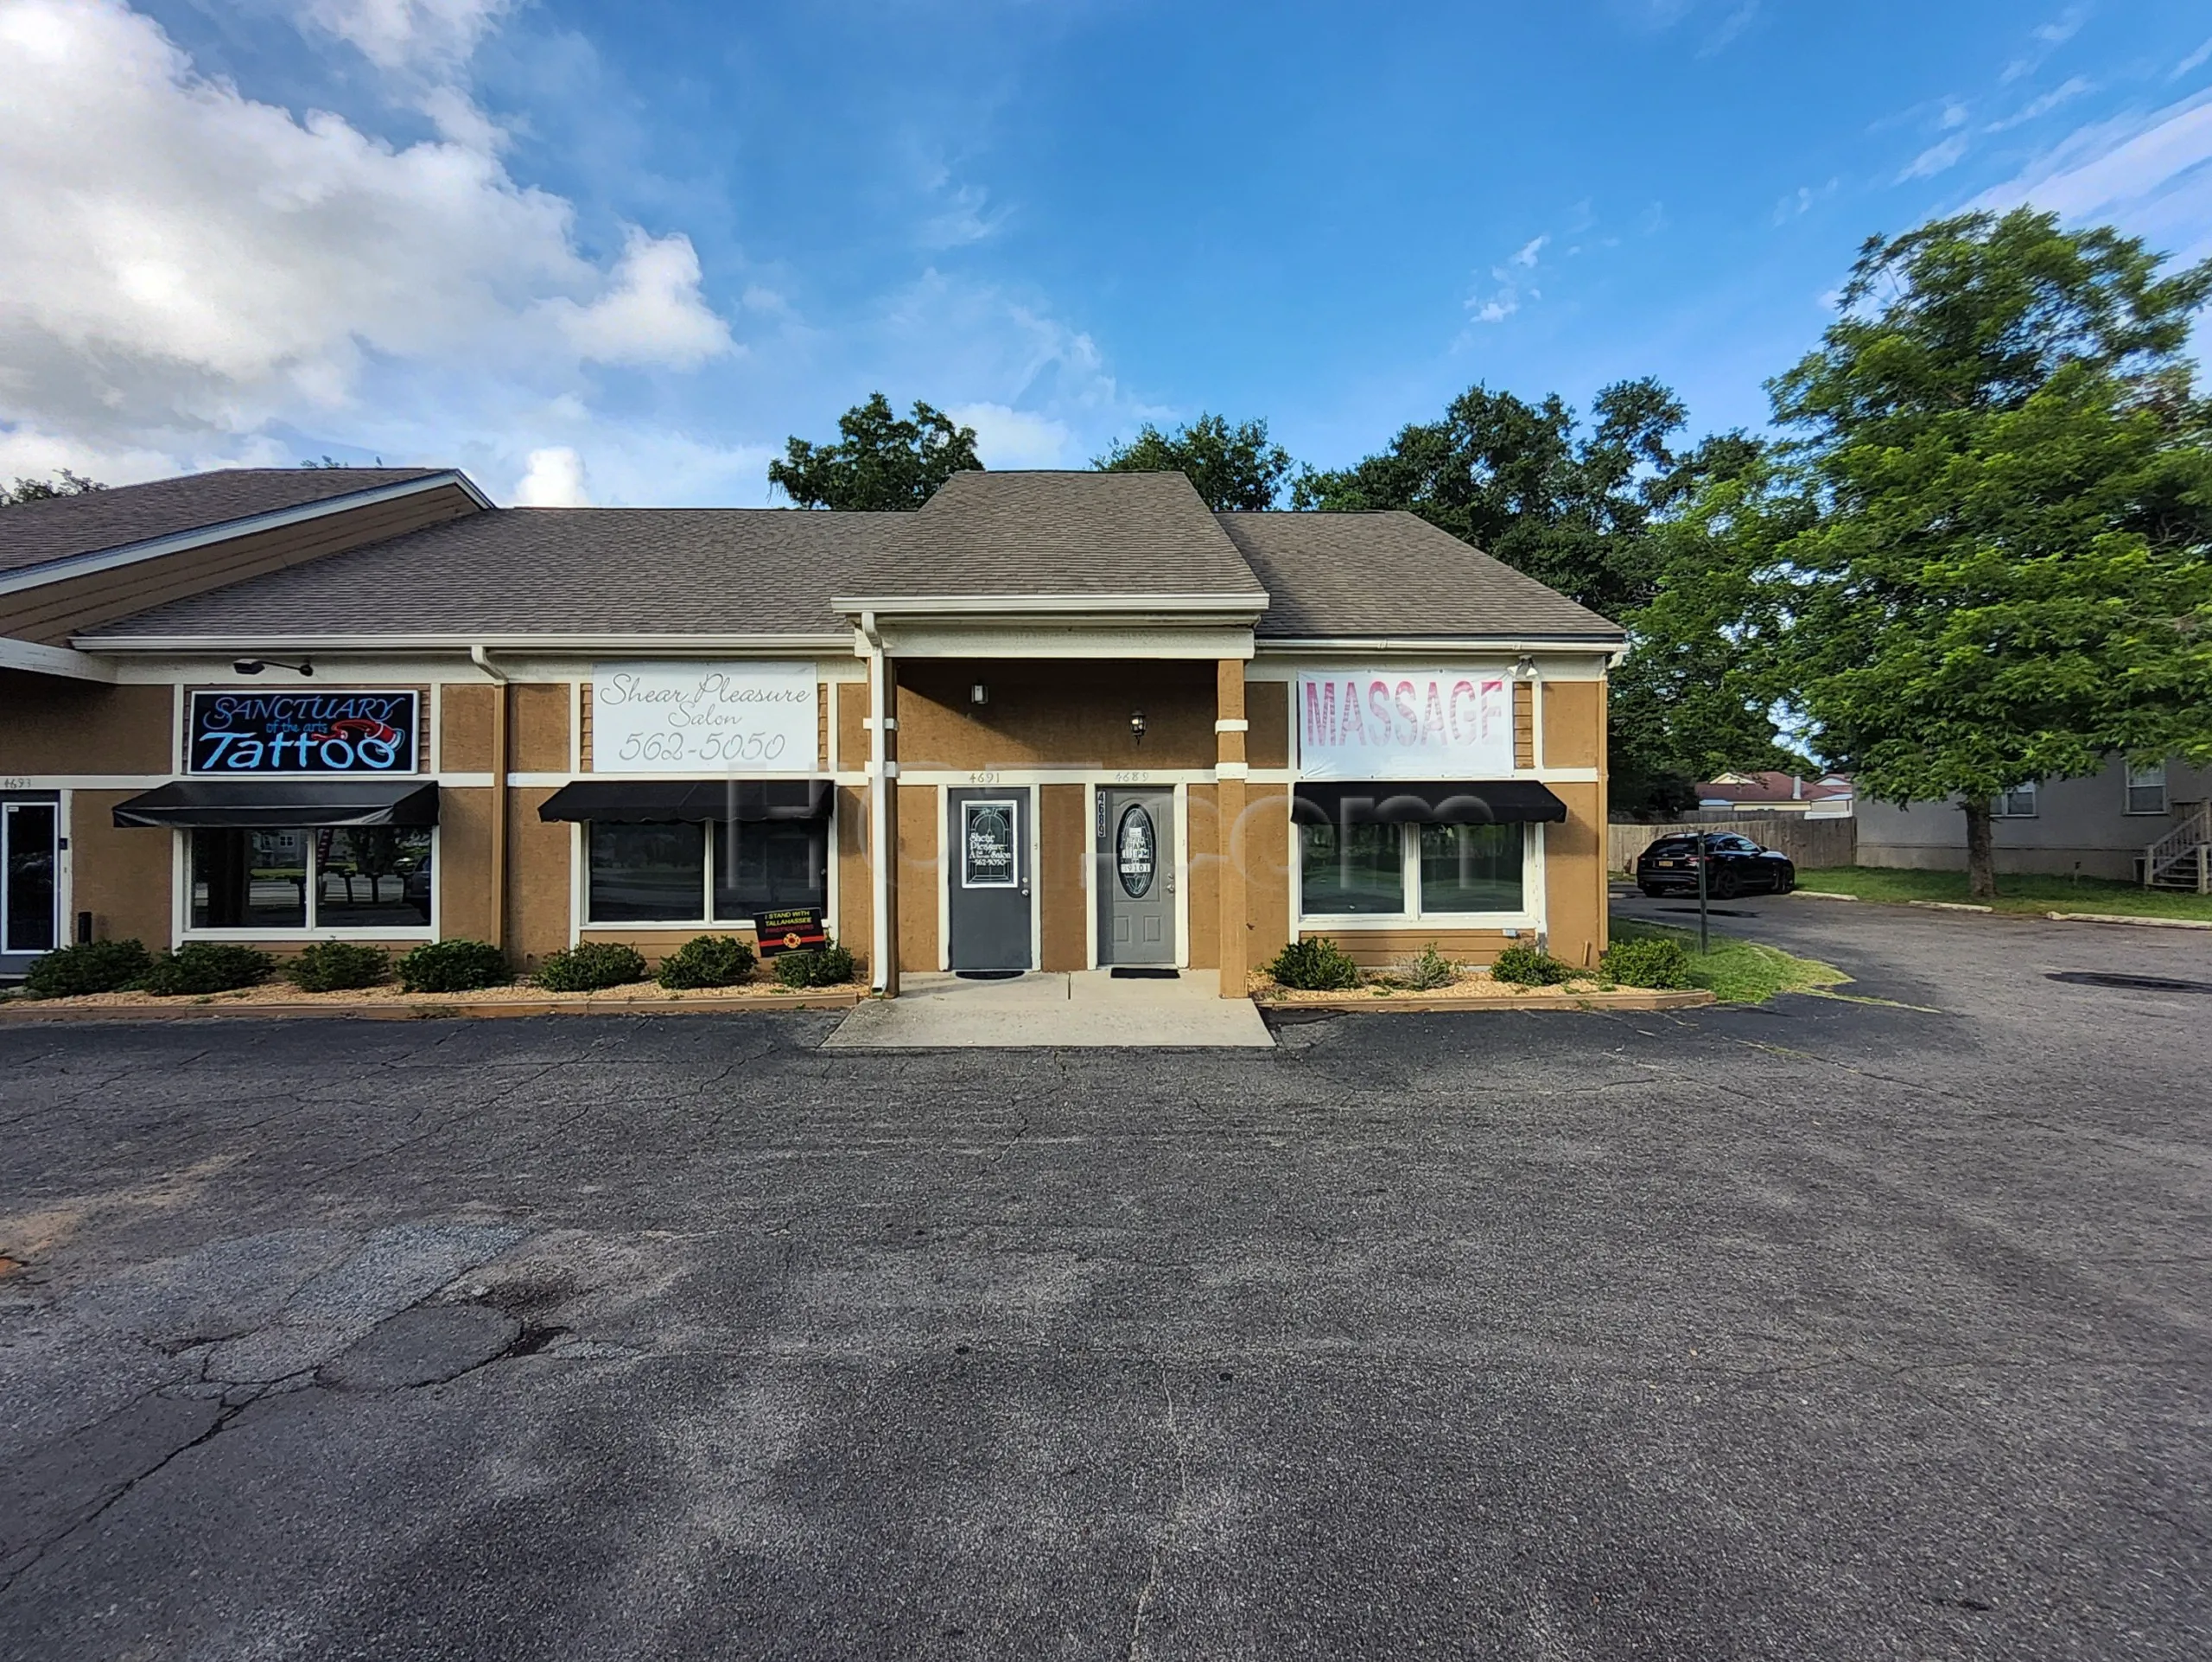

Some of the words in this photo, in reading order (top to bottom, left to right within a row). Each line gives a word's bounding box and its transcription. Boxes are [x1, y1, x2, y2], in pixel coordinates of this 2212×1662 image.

[599, 672, 690, 705] Shear
[688, 672, 810, 705] Pleasure
[203, 695, 406, 730] SANCTUARY
[266, 718, 277, 733] of
[281, 718, 300, 733] the
[303, 721, 328, 733] arts
[668, 700, 742, 728] Salon
[1306, 680, 1503, 747] MASSAGE
[199, 731, 395, 769] Tattoo
[619, 731, 785, 761] 562-5050
[969, 773, 1000, 783] 4691
[1115, 772, 1148, 782] 4689
[765, 917, 812, 927] TALLAHASSEE
